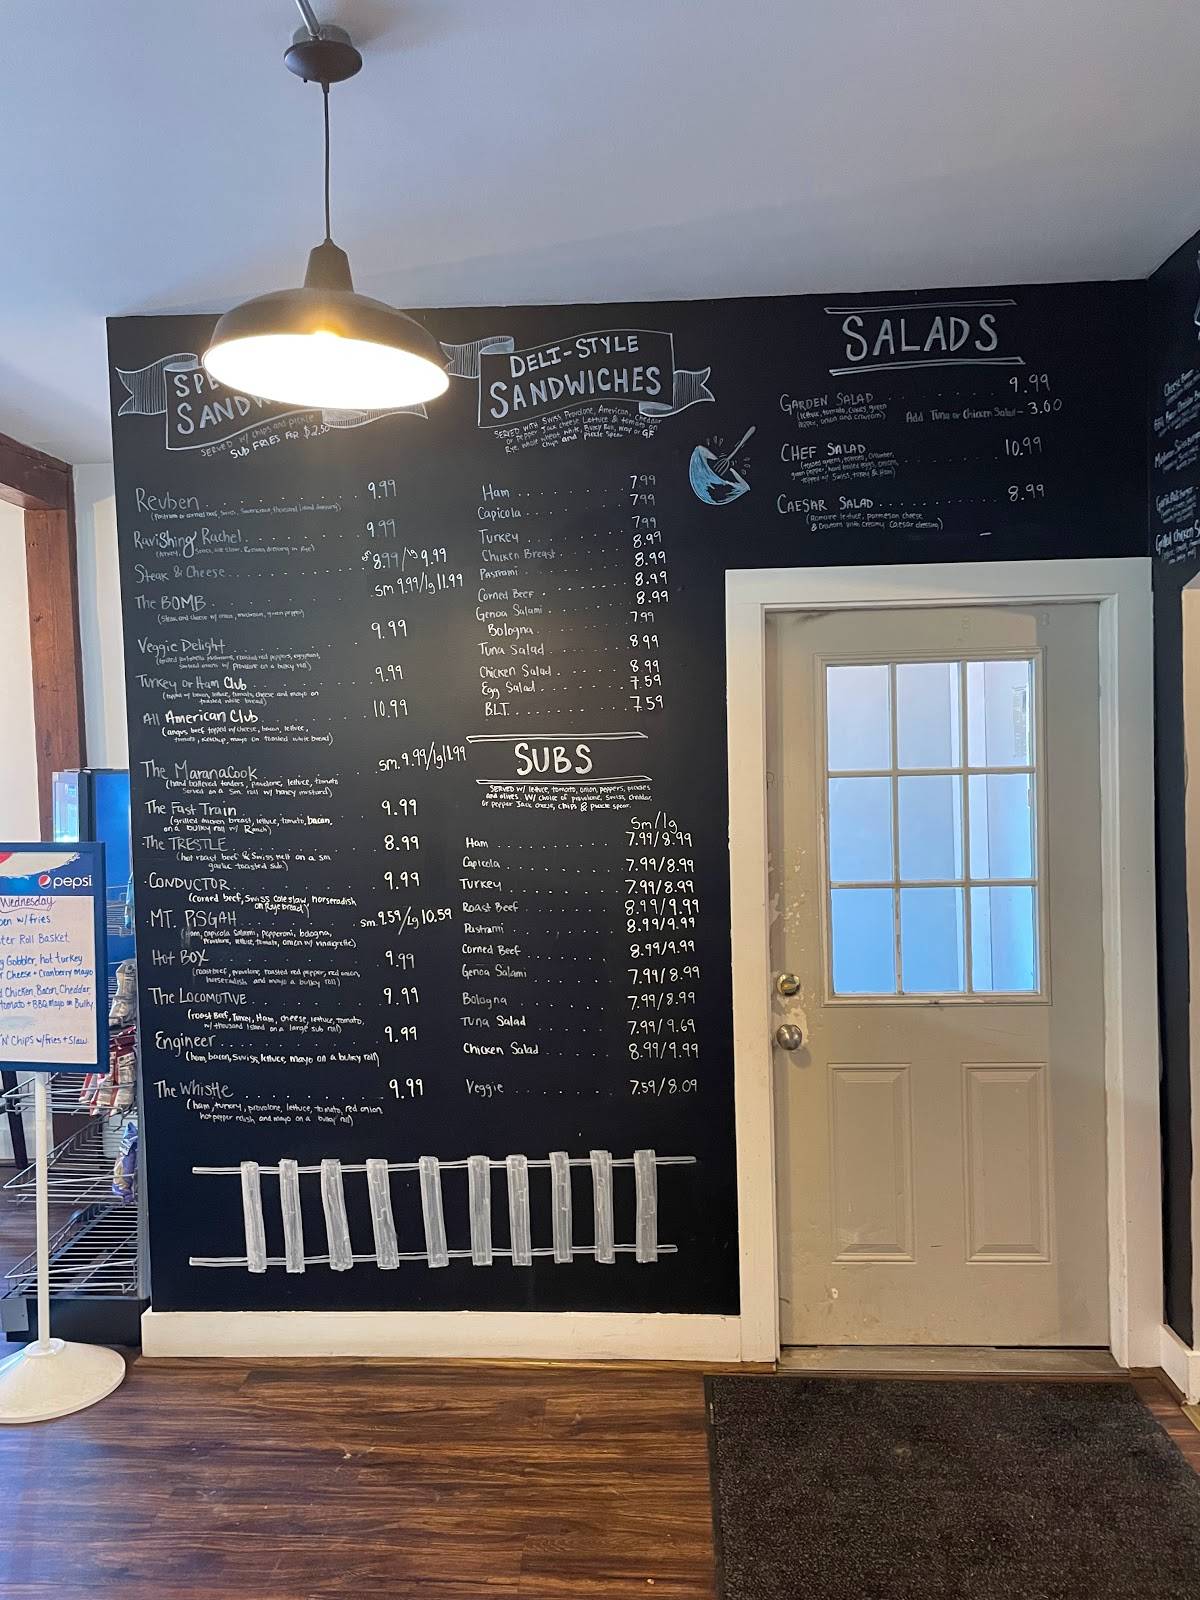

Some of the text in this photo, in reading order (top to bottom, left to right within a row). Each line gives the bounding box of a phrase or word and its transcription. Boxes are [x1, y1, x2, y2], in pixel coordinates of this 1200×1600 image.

[842, 313, 998, 361] SALADS
[509, 335, 639, 378] DELI-STYLE
[490, 366, 662, 419] SANDWICHES
[779, 374, 1050, 415] GARDEN SALAD 9.99
[906, 411, 924, 423] Add
[930, 409, 950, 421] Tuna
[1027, 398, 1062, 415] 3.00
[252, 424, 331, 451] FRIES $2.50
[493, 427, 520, 439] SERVED
[561, 433, 578, 443] and
[641, 429, 655, 439] GF
[201, 440, 233, 457] SERVED
[781, 436, 1042, 462] CHEF SALAD 10.99
[135, 487, 200, 513] Reuben
[367, 479, 397, 500] 9.99
[482, 483, 510, 501] Ham
[777, 484, 1045, 514] CAESAR SALAD 8.99
[477, 506, 522, 522] Capicola
[201, 527, 242, 544] Rachel
[366, 519, 396, 541] 9.99
[478, 528, 519, 545] Turkey
[481, 531, 661, 562] Chicken Breast 8.99
[134, 547, 447, 584] Steak & Cheese 9.99
[635, 550, 666, 567] 8.99
[478, 570, 668, 603] Corned 8.99
[135, 594, 206, 612] The BOMB
[476, 590, 669, 623] Genoa Salami 8.99
[138, 619, 408, 658] Veggie Delight 9.99
[487, 623, 534, 640] Bologna
[478, 641, 545, 656] Tuna Salad
[136, 664, 403, 691] Turkey or Ham Club 9.99
[479, 665, 552, 679] Chicken Salad
[481, 681, 500, 699] Egg
[505, 680, 536, 693] Salad
[143, 699, 408, 726] All American Club 10.99
[514, 742, 593, 776] SUBS
[140, 759, 168, 780] The
[145, 799, 417, 816] The Fast Train 9.99
[580, 801, 588, 812] &
[144, 835, 420, 851] The TRESTLE 8.99
[465, 831, 693, 849] Ham 7.99/8.99
[462, 856, 694, 873] Capicola 7.99/8.99
[53, 875, 92, 889] pepsi
[149, 871, 421, 891] CONDUCTOR 9.99
[459, 878, 694, 895] Turkey 7.99/8.99
[1, 896, 56, 911] Wednesday
[462, 898, 699, 916] Roast Beef 8.99/9.99
[150, 908, 452, 928] MT. 10.59
[464, 917, 696, 934] Pastrami 8.99/9.99
[19, 934, 34, 945] Roll
[39, 932, 70, 944] Basket
[40, 951, 83, 967] hot turkey
[462, 940, 695, 959] Corned Beef 8.99/9.99
[152, 950, 176, 966] Hot
[385, 949, 415, 970] 9.99
[6, 967, 72, 980] Cheese Cranberry
[461, 963, 700, 985] Genoa Salami 7.99/8.99
[32, 999, 48, 1009] BBQ
[148, 987, 419, 1006] The LOCOMOTIVE 9.99
[462, 991, 696, 1011] Bologna 7.99/8.99
[459, 1015, 696, 1036] Tuna Salad 7.99/9.69
[11, 1035, 88, 1047] Chips Slaw
[155, 1026, 418, 1057] Engineer 9.99
[463, 1041, 699, 1060] Chicken Salad 8.99/9.99
[316, 1055, 327, 1063] on
[330, 1054, 337, 1062] a
[153, 1078, 425, 1099] The Whistle 9.99
[466, 1077, 698, 1098] Veggie 7.59/8.09
